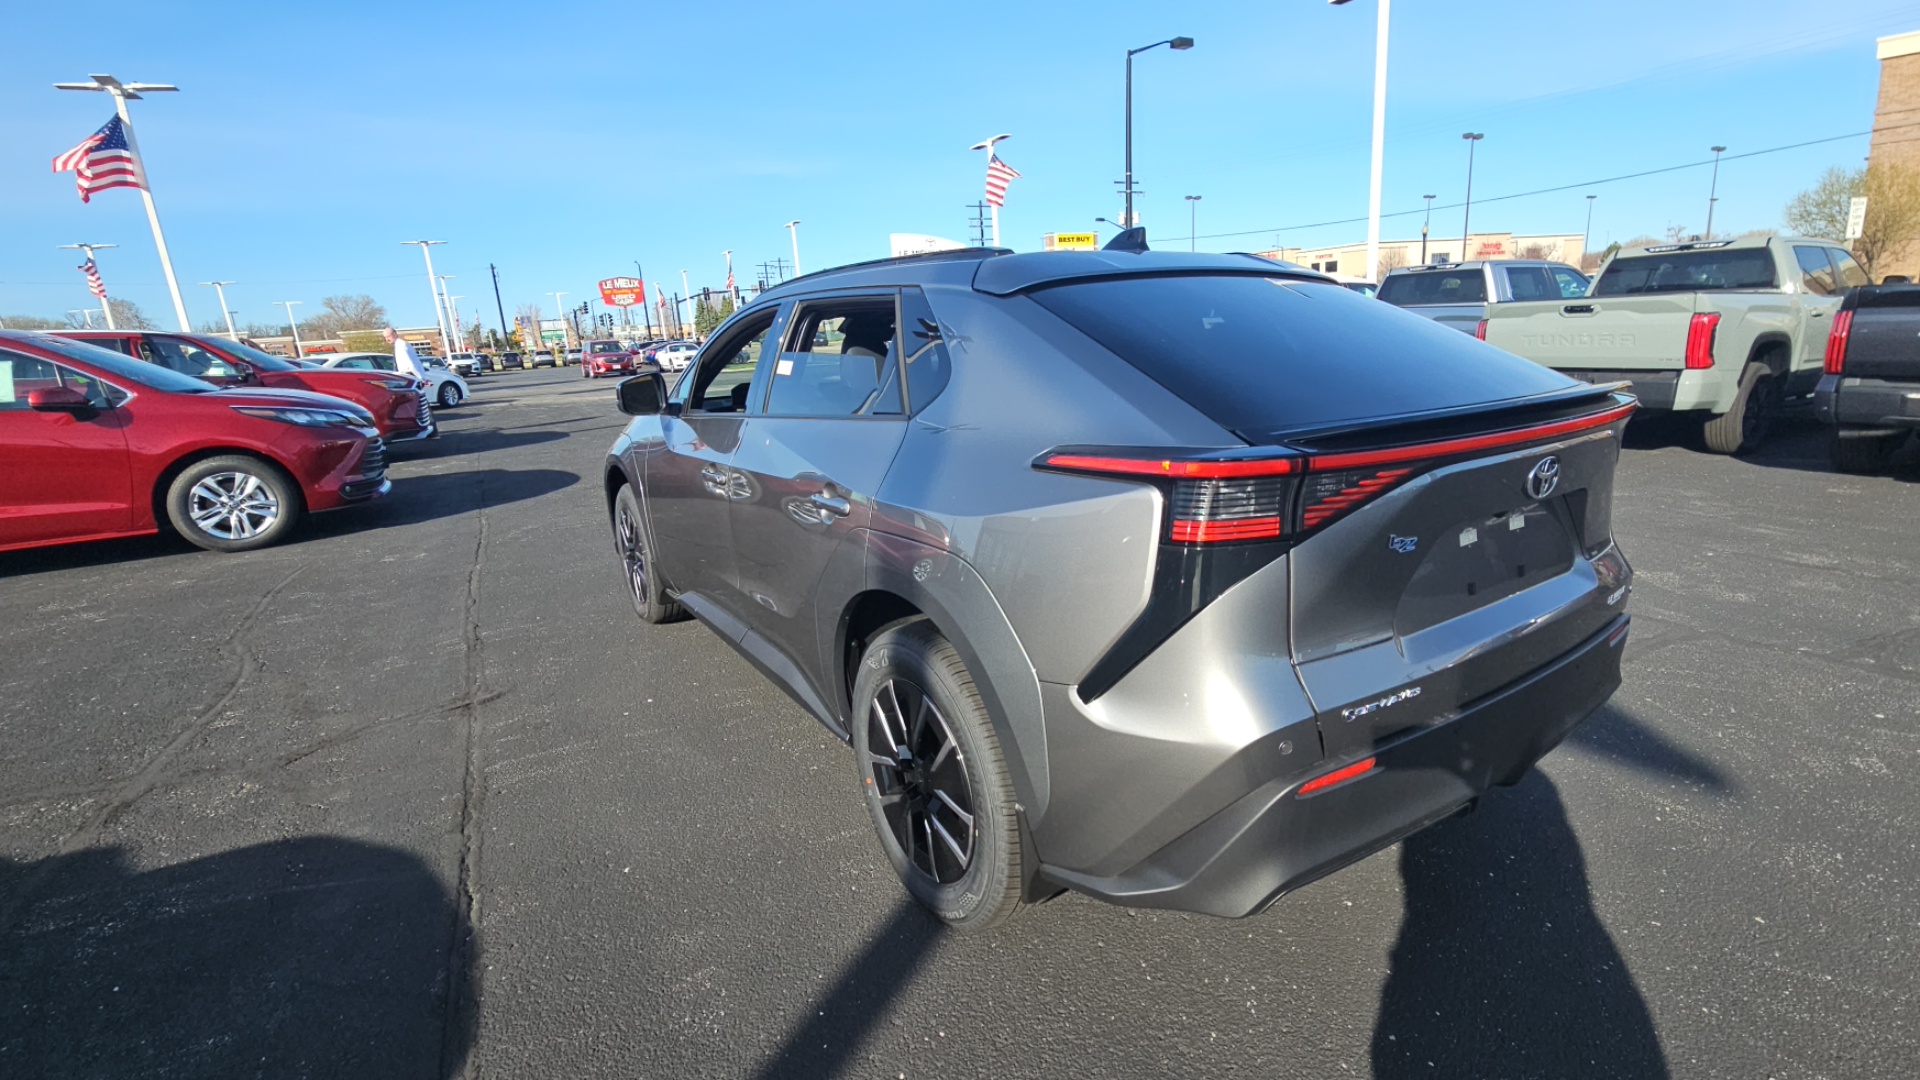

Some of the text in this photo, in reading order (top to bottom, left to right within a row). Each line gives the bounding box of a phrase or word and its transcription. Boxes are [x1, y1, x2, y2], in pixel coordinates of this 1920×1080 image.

[602, 278, 640, 289] LE MIEUX
[1521, 333, 1636, 347] TUNDRA
